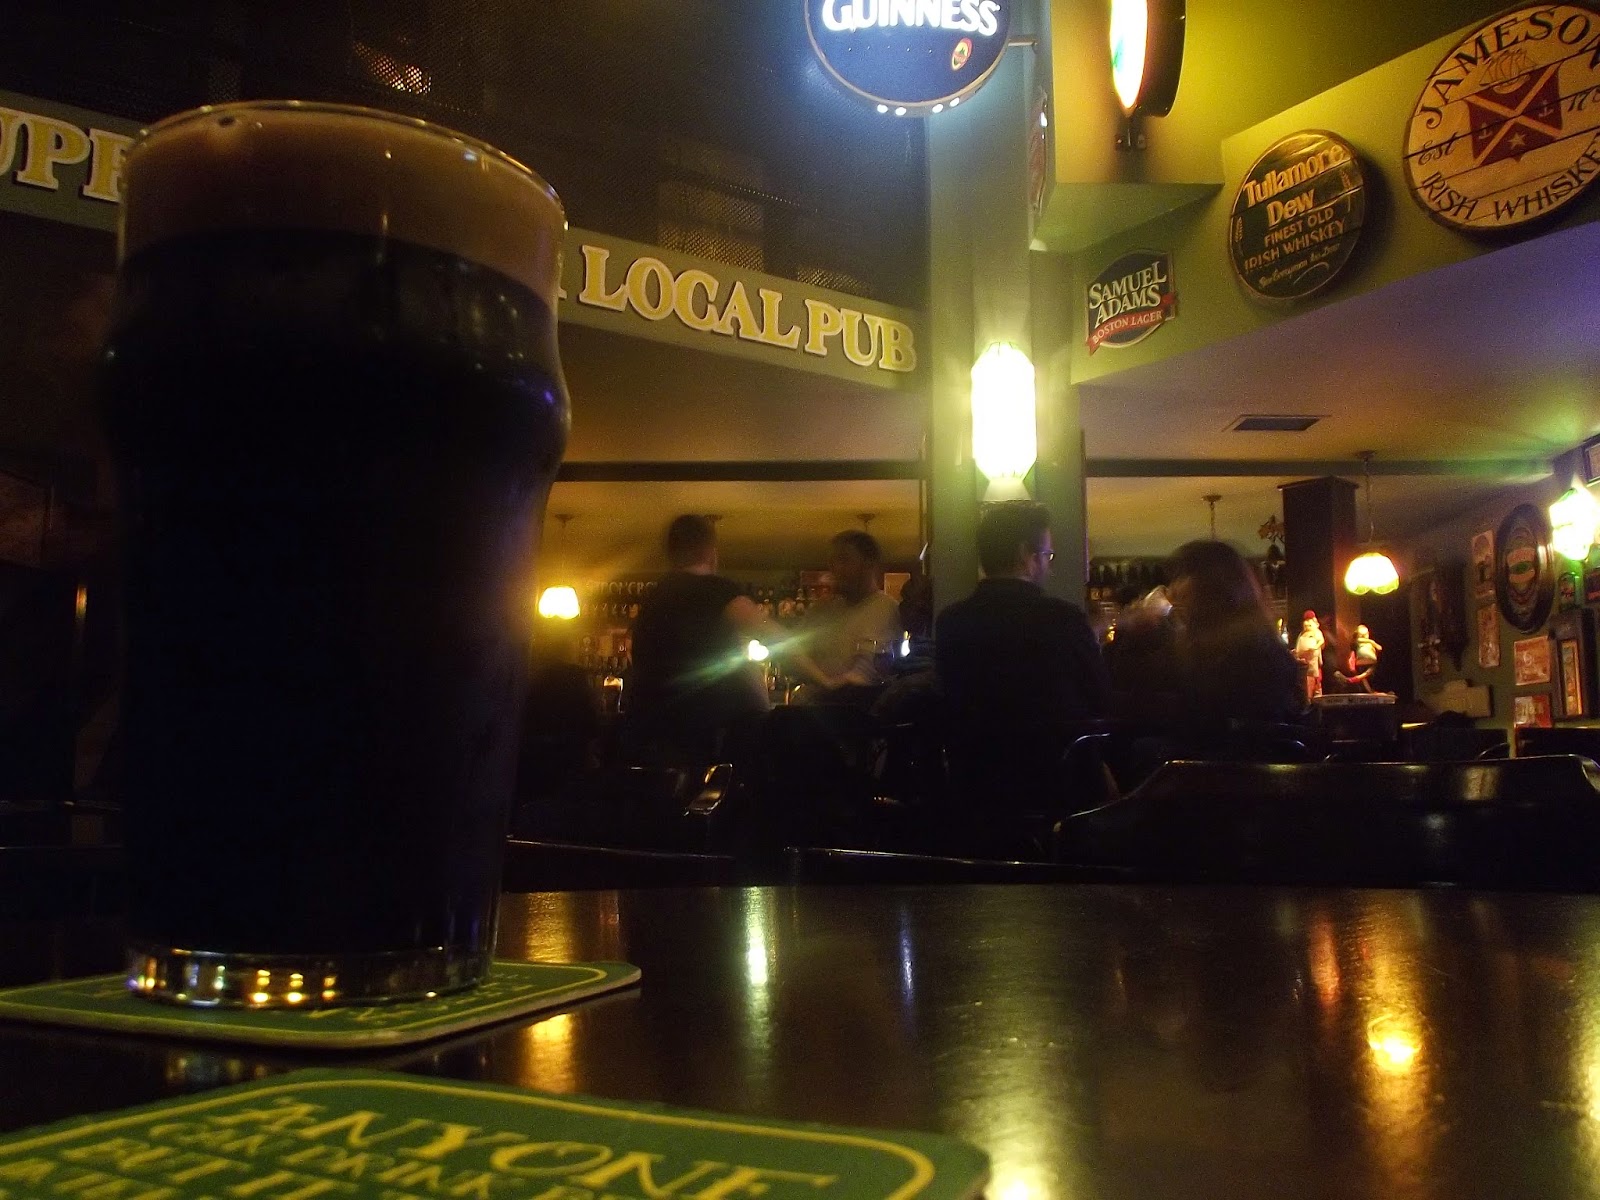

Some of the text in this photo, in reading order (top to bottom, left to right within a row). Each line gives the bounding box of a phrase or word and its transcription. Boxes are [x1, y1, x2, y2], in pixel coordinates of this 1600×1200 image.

[821, 0, 1001, 36] GUINNESS
[1242, 144, 1346, 208] Tullamore
[1421, 131, 1600, 221] IRISH WHISKE
[1264, 207, 1335, 248] FINEST OLD
[1266, 189, 1316, 229] Dew
[1244, 247, 1280, 274] IRISH
[1282, 218, 1346, 255] WHISKEY
[579, 245, 917, 373] LOCAL PUB
[1089, 261, 1167, 309] SAMUEL
[1094, 284, 1162, 330] ADAMS
[1092, 310, 1163, 344] BOSTON LAGER
[203, 1098, 840, 1200] ANYONE
